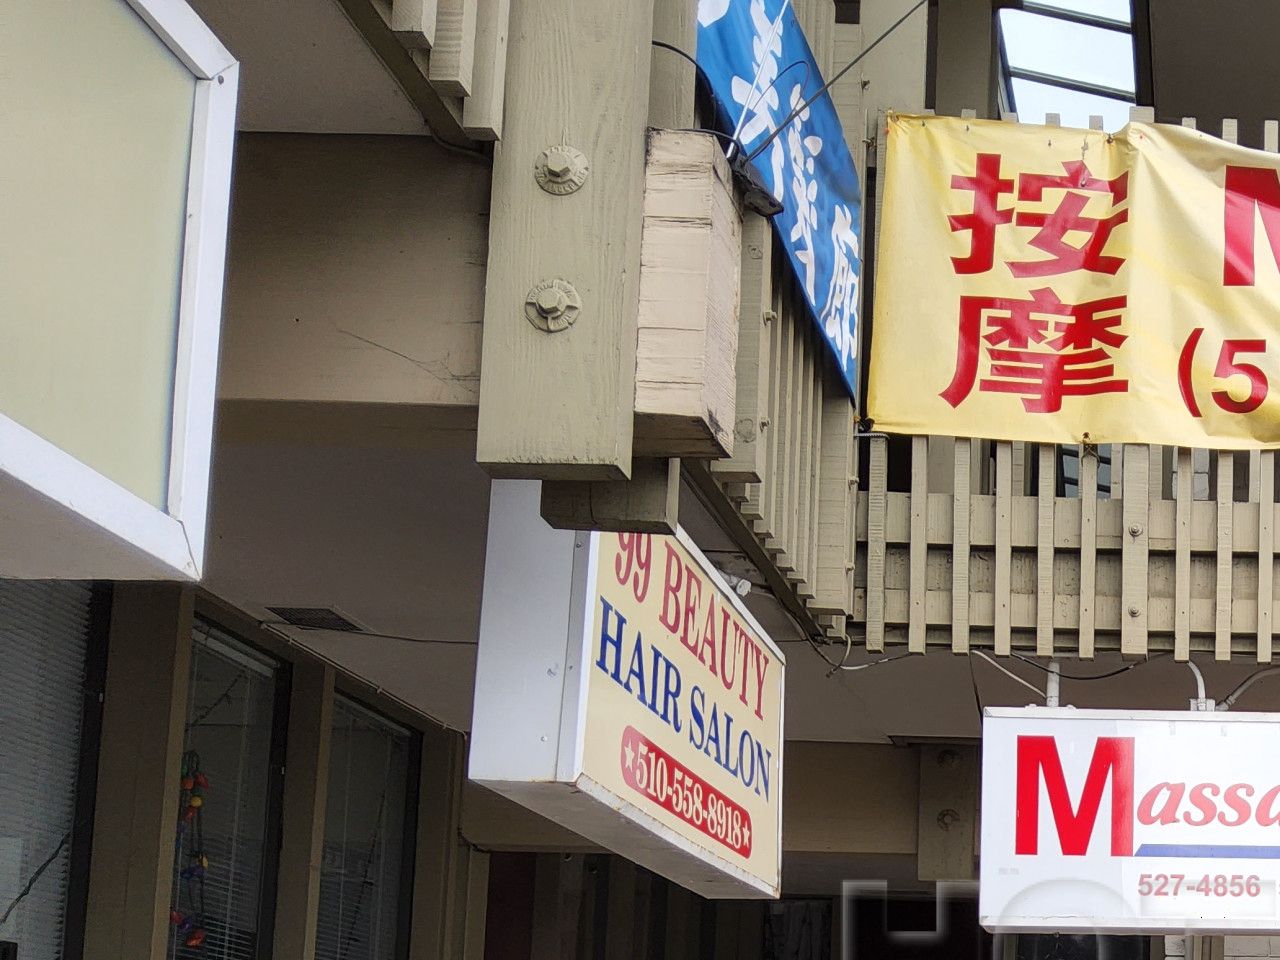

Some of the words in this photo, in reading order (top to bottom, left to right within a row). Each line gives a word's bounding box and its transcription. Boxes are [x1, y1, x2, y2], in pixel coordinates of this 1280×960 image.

[938, 153, 1128, 413] 按摩
[596, 596, 682, 733] HAIR
[689, 685, 771, 803] SALON
[659, 540, 769, 721] BEAUTY
[634, 738, 741, 850] 510-558-8918
[1138, 874, 1261, 897] 527-4856
